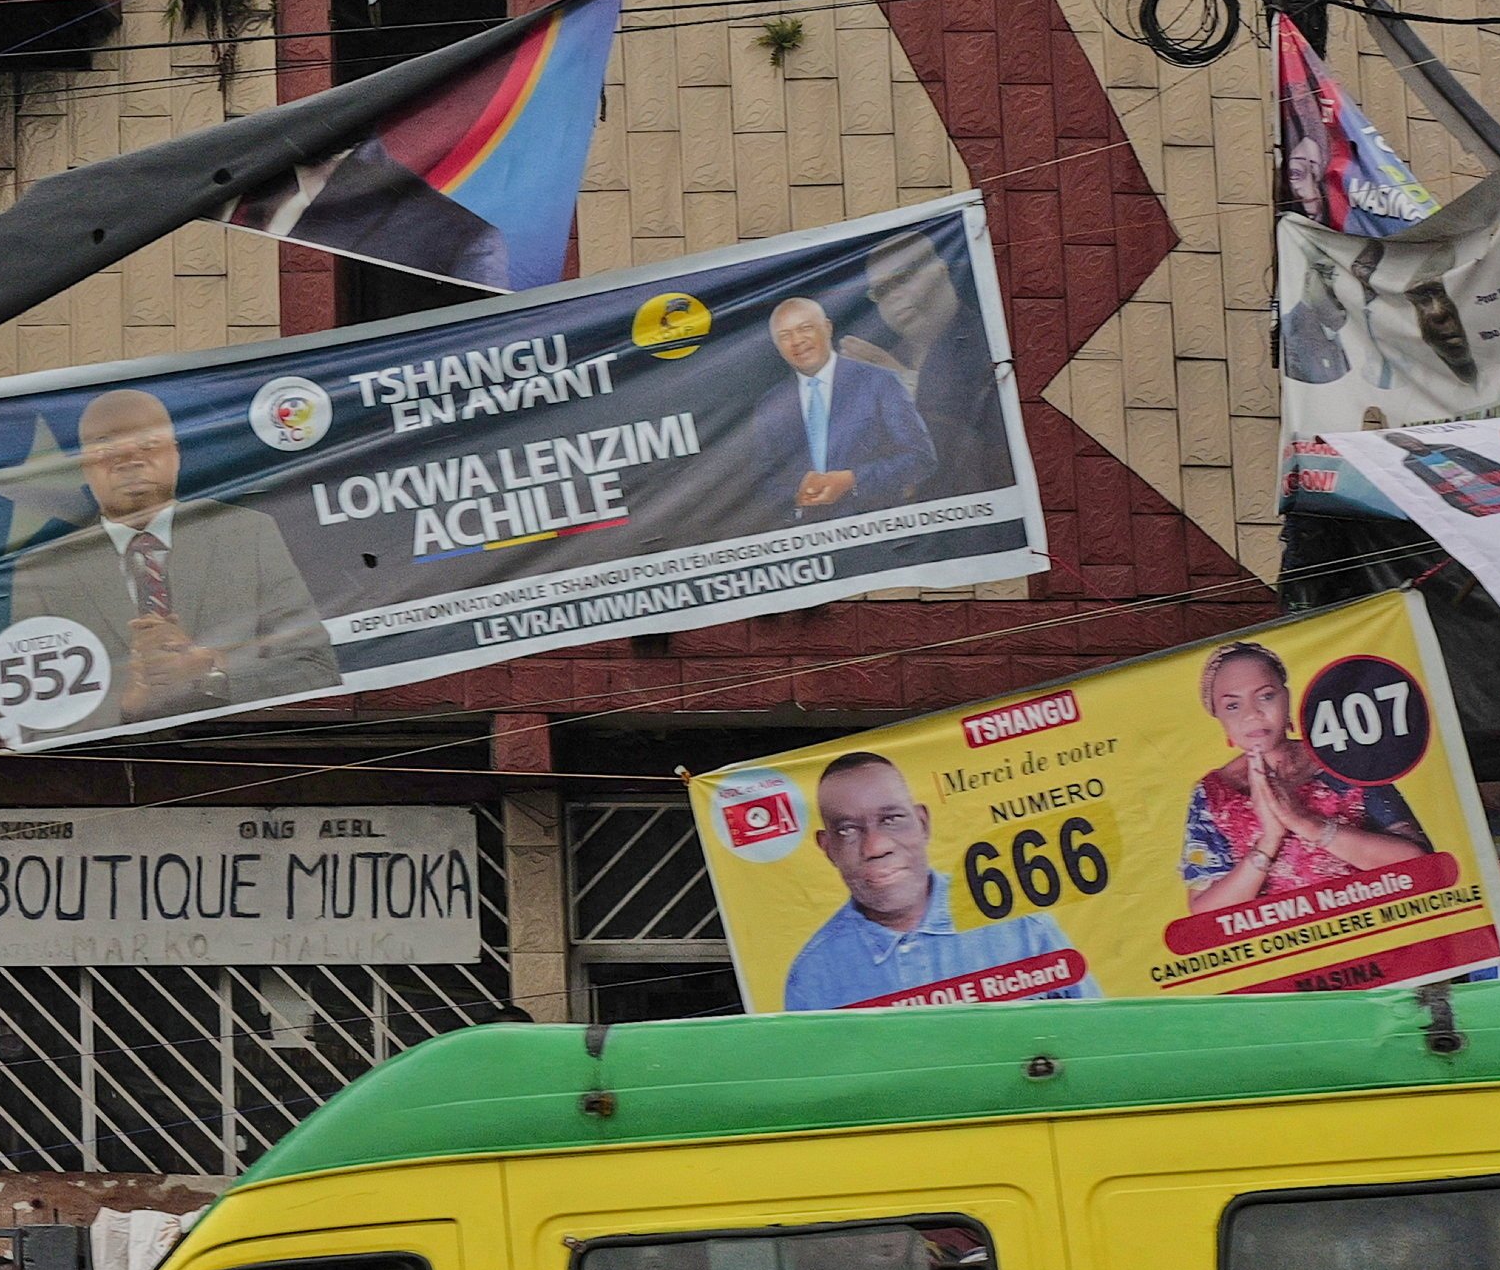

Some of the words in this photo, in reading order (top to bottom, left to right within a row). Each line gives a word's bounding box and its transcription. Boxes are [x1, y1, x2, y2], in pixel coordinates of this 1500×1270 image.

[350, 334, 566, 408] TSHANGU
[392, 396, 454, 435] EN
[460, 352, 617, 432] AVANT
[313, 455, 498, 526] LOKWA
[503, 413, 701, 495] LENZIMI
[412, 470, 628, 552] ACHILLE
[551, 568, 631, 596] TSHANGU
[633, 561, 680, 579] POUR
[921, 502, 993, 526] DISCOURS
[475, 620, 507, 645] LE
[511, 607, 581, 639] VRAI
[582, 587, 693, 628] MWANA
[699, 555, 835, 603] TSHANGU
[965, 695, 1077, 746] TSHANGU
[1310, 681, 1409, 753] 407
[944, 758, 1013, 797] Merci
[1022, 749, 1050, 775] de
[1056, 737, 1117, 767] voter
[991, 778, 1104, 823] NUMERO
[240, 821, 295, 839] ONG
[287, 850, 473, 918] MUTOKA
[964, 816, 1108, 919] 666
[1151, 943, 1254, 981] CANDIDATE
[1261, 913, 1374, 954] CONSILLERE
[1380, 885, 1482, 922] MUNICIPALE
[1217, 897, 1315, 937] TALEWA
[1316, 872, 1413, 910] Nathalie
[981, 958, 1071, 996] Richard
